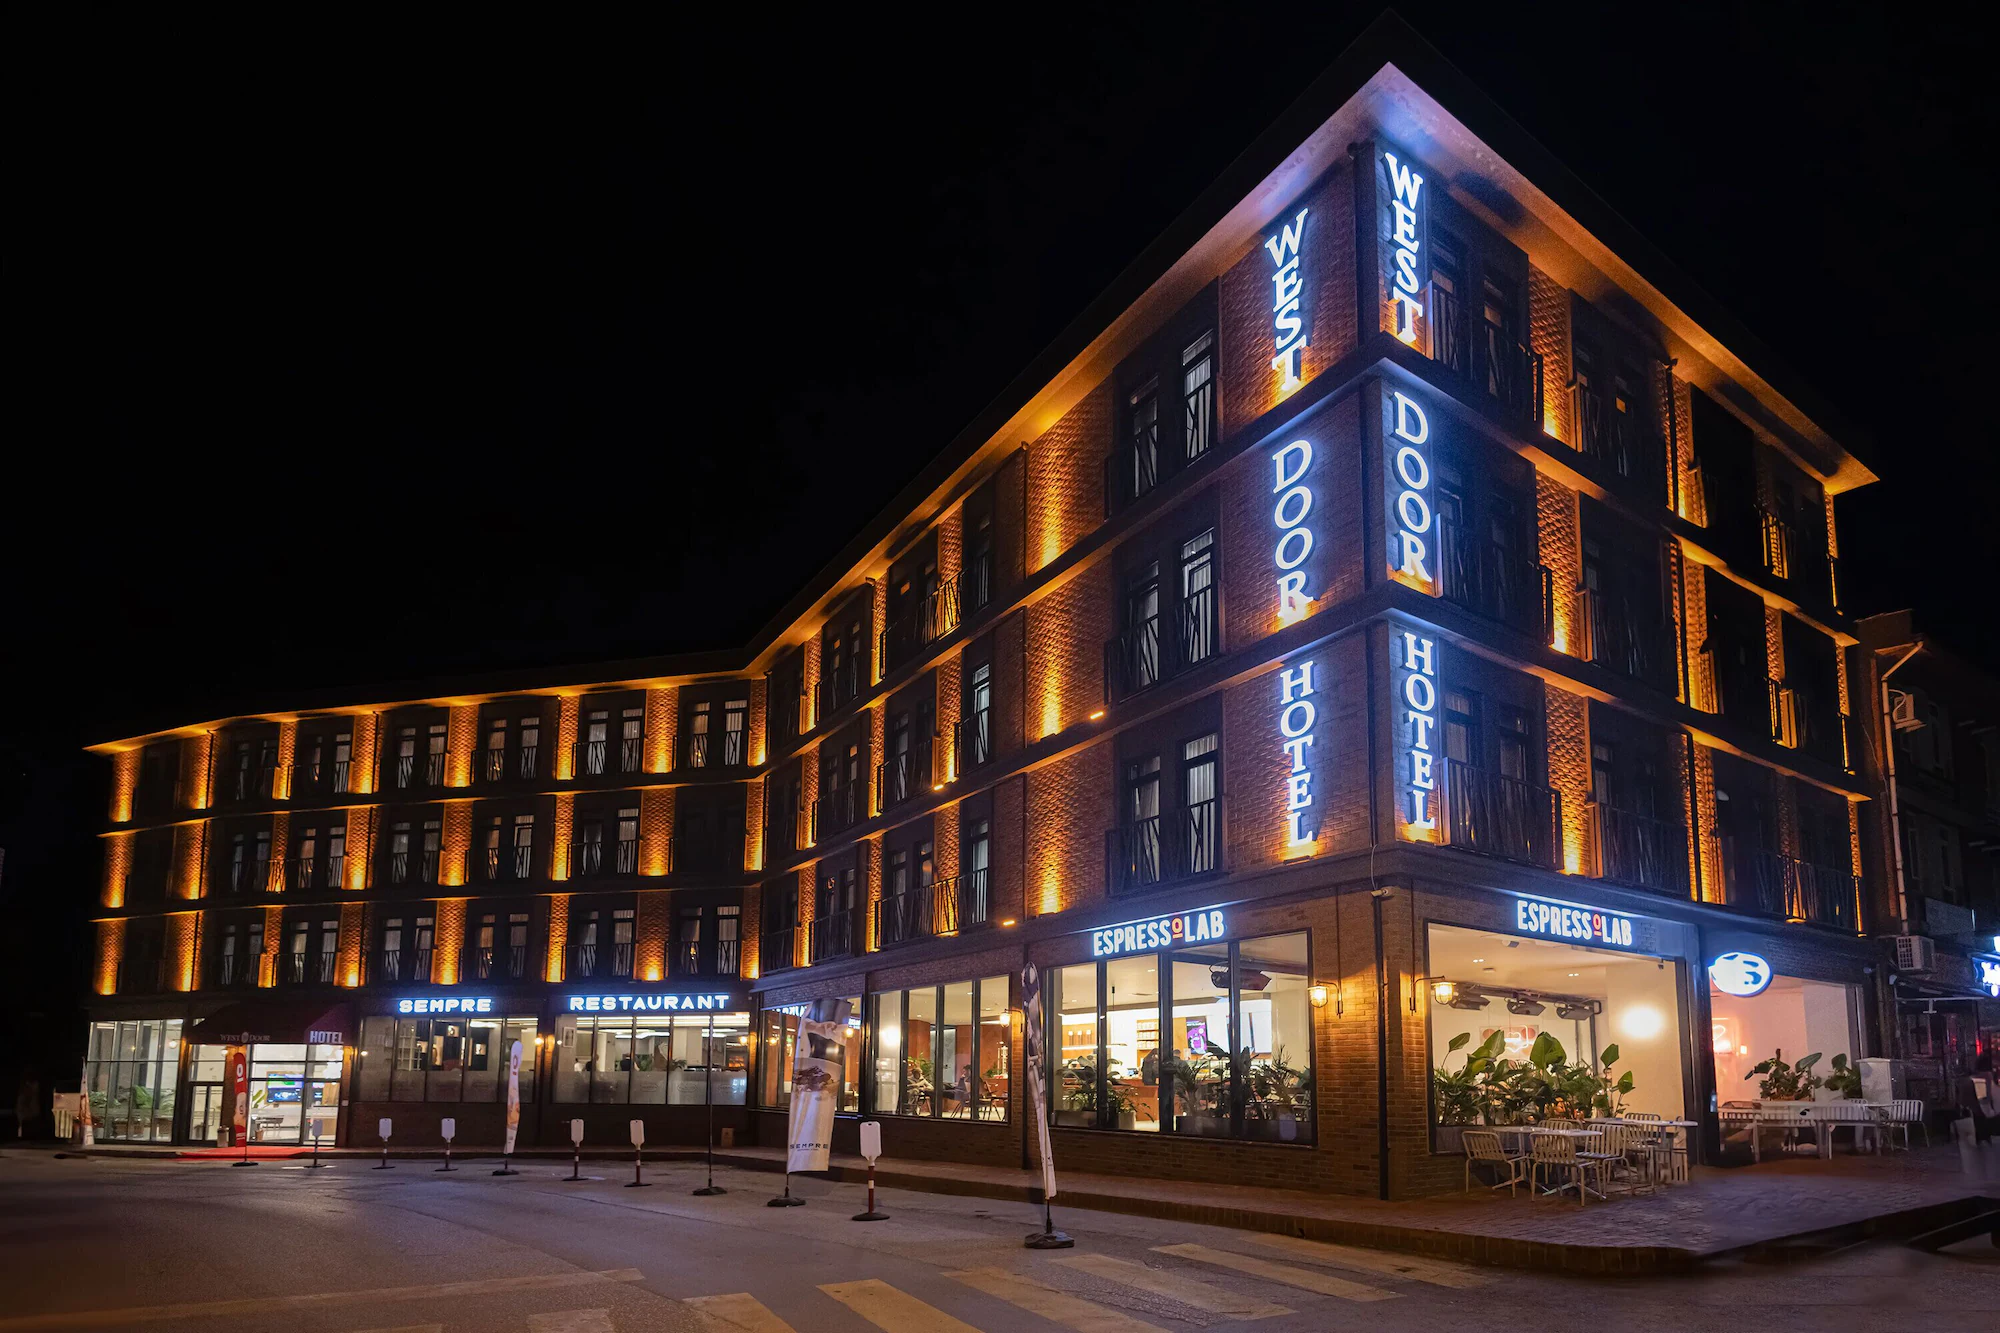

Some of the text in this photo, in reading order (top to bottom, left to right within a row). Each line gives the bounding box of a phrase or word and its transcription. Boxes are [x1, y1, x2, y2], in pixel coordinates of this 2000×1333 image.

[1385, 152, 1435, 830] WEST DOOR HOTEL
[1264, 208, 1316, 848] WEST DOOR HOTEL
[399, 995, 730, 1013] SEMPRE RESTAURANT
[220, 1033, 270, 1042] WEST DOOR
[309, 1030, 344, 1044] HOTEL
